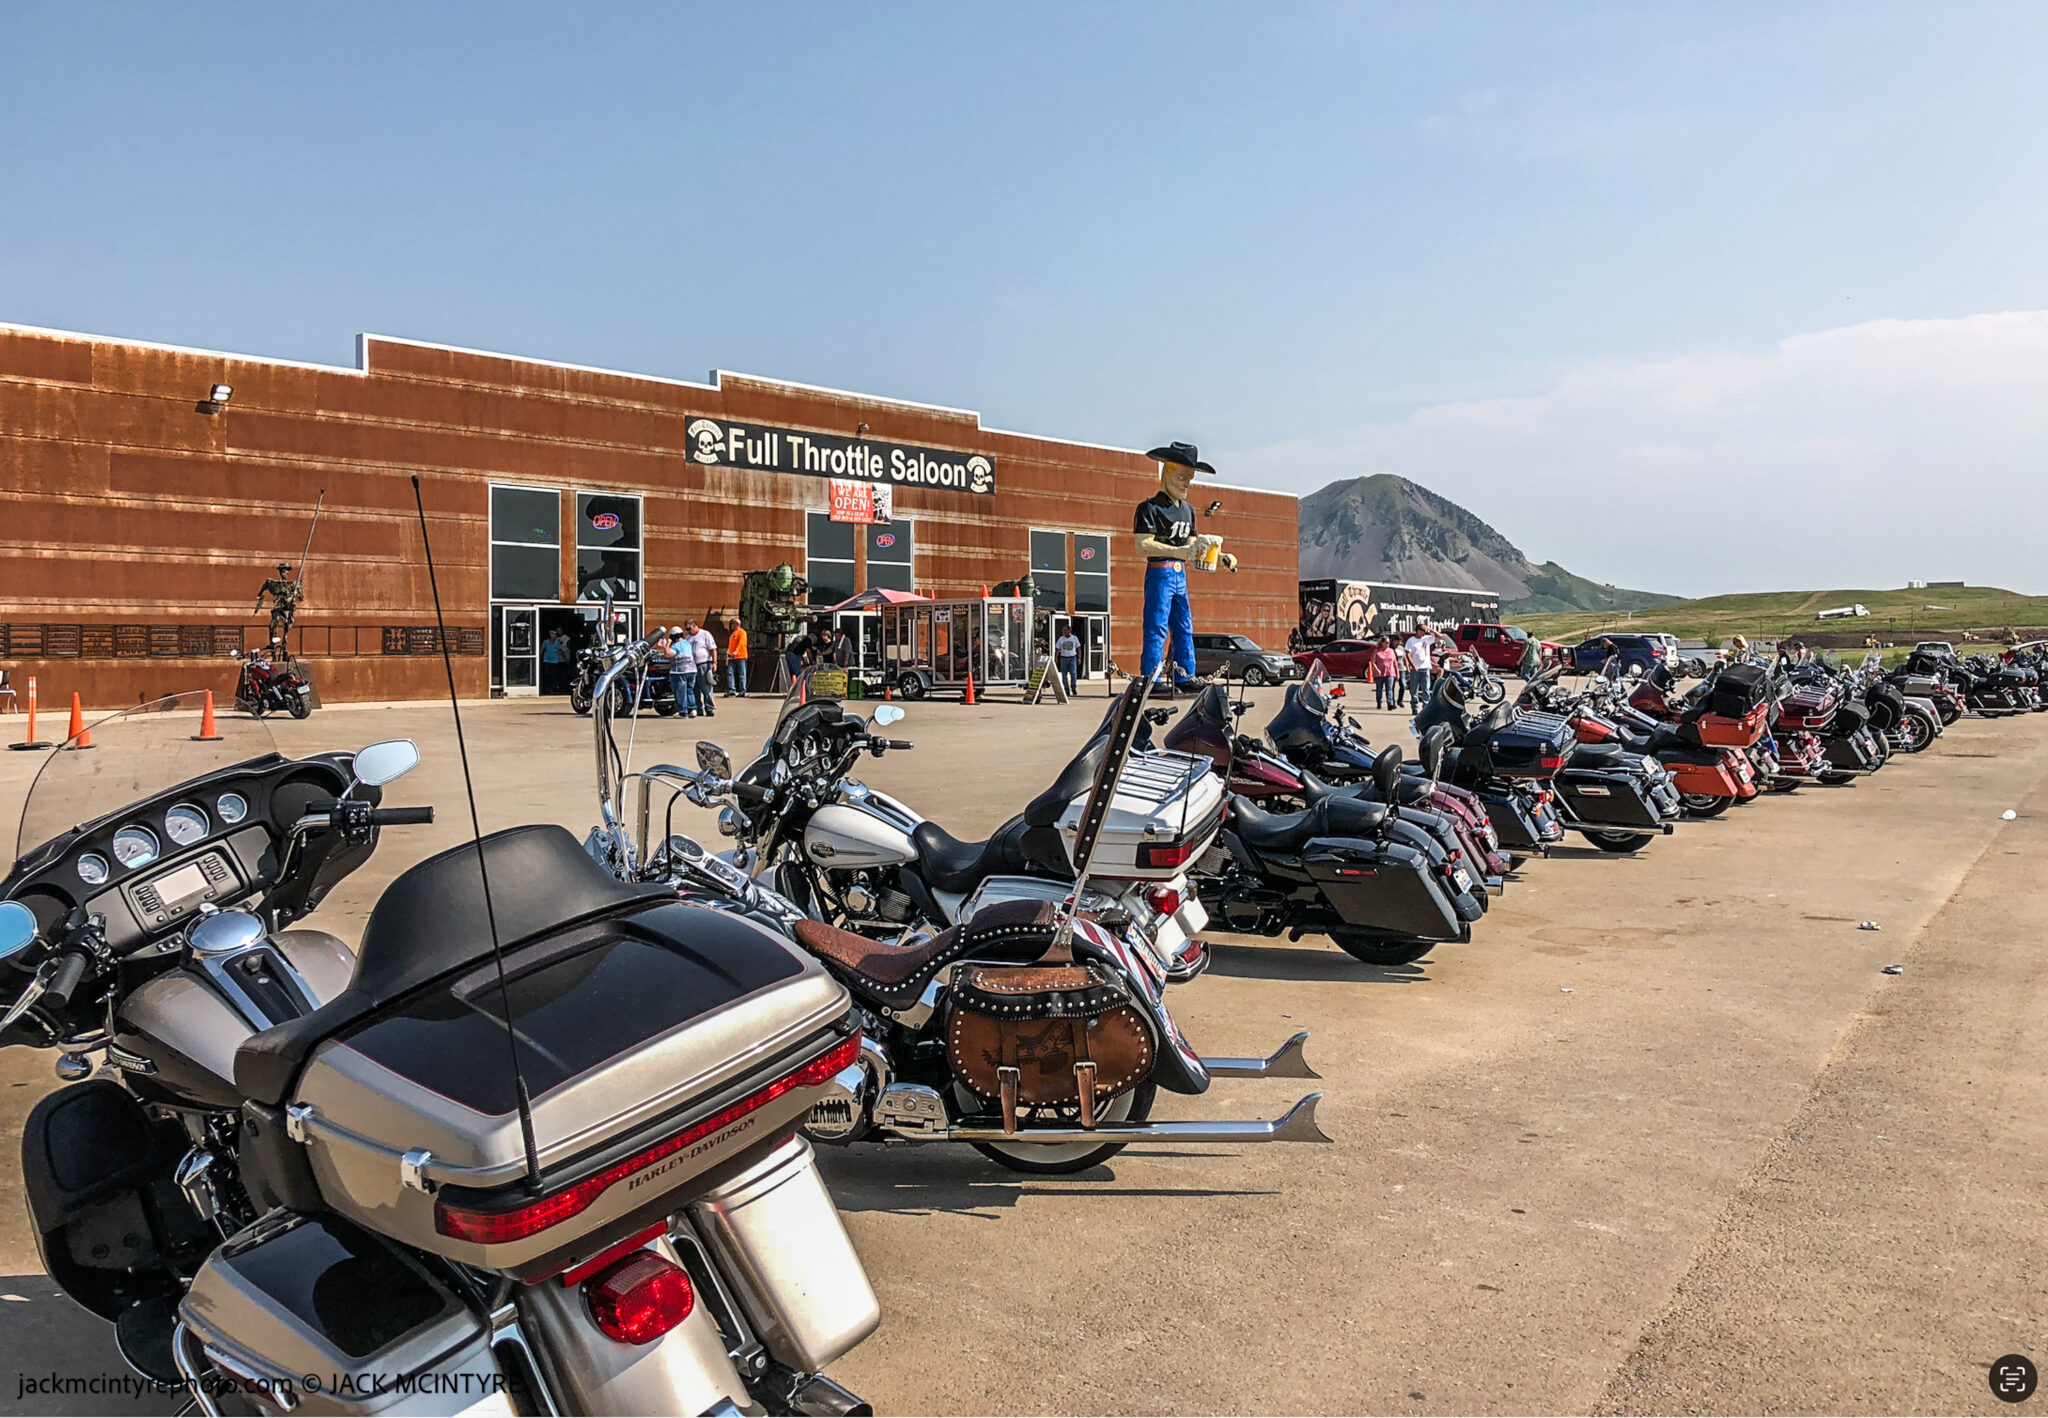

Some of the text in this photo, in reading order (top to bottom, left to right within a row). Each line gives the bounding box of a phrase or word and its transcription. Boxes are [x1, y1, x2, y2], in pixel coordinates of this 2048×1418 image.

[728, 428, 779, 468] Full
[786, 435, 884, 478] Throttle
[890, 449, 967, 487] Saloon
[853, 489, 868, 500] ARE
[834, 496, 871, 512] OPEN!
[593, 514, 617, 528] OPEN
[1380, 602, 1406, 610] Michael
[1388, 613, 1413, 634] Full
[628, 1115, 757, 1191] HARLEY-DAVIDSON
